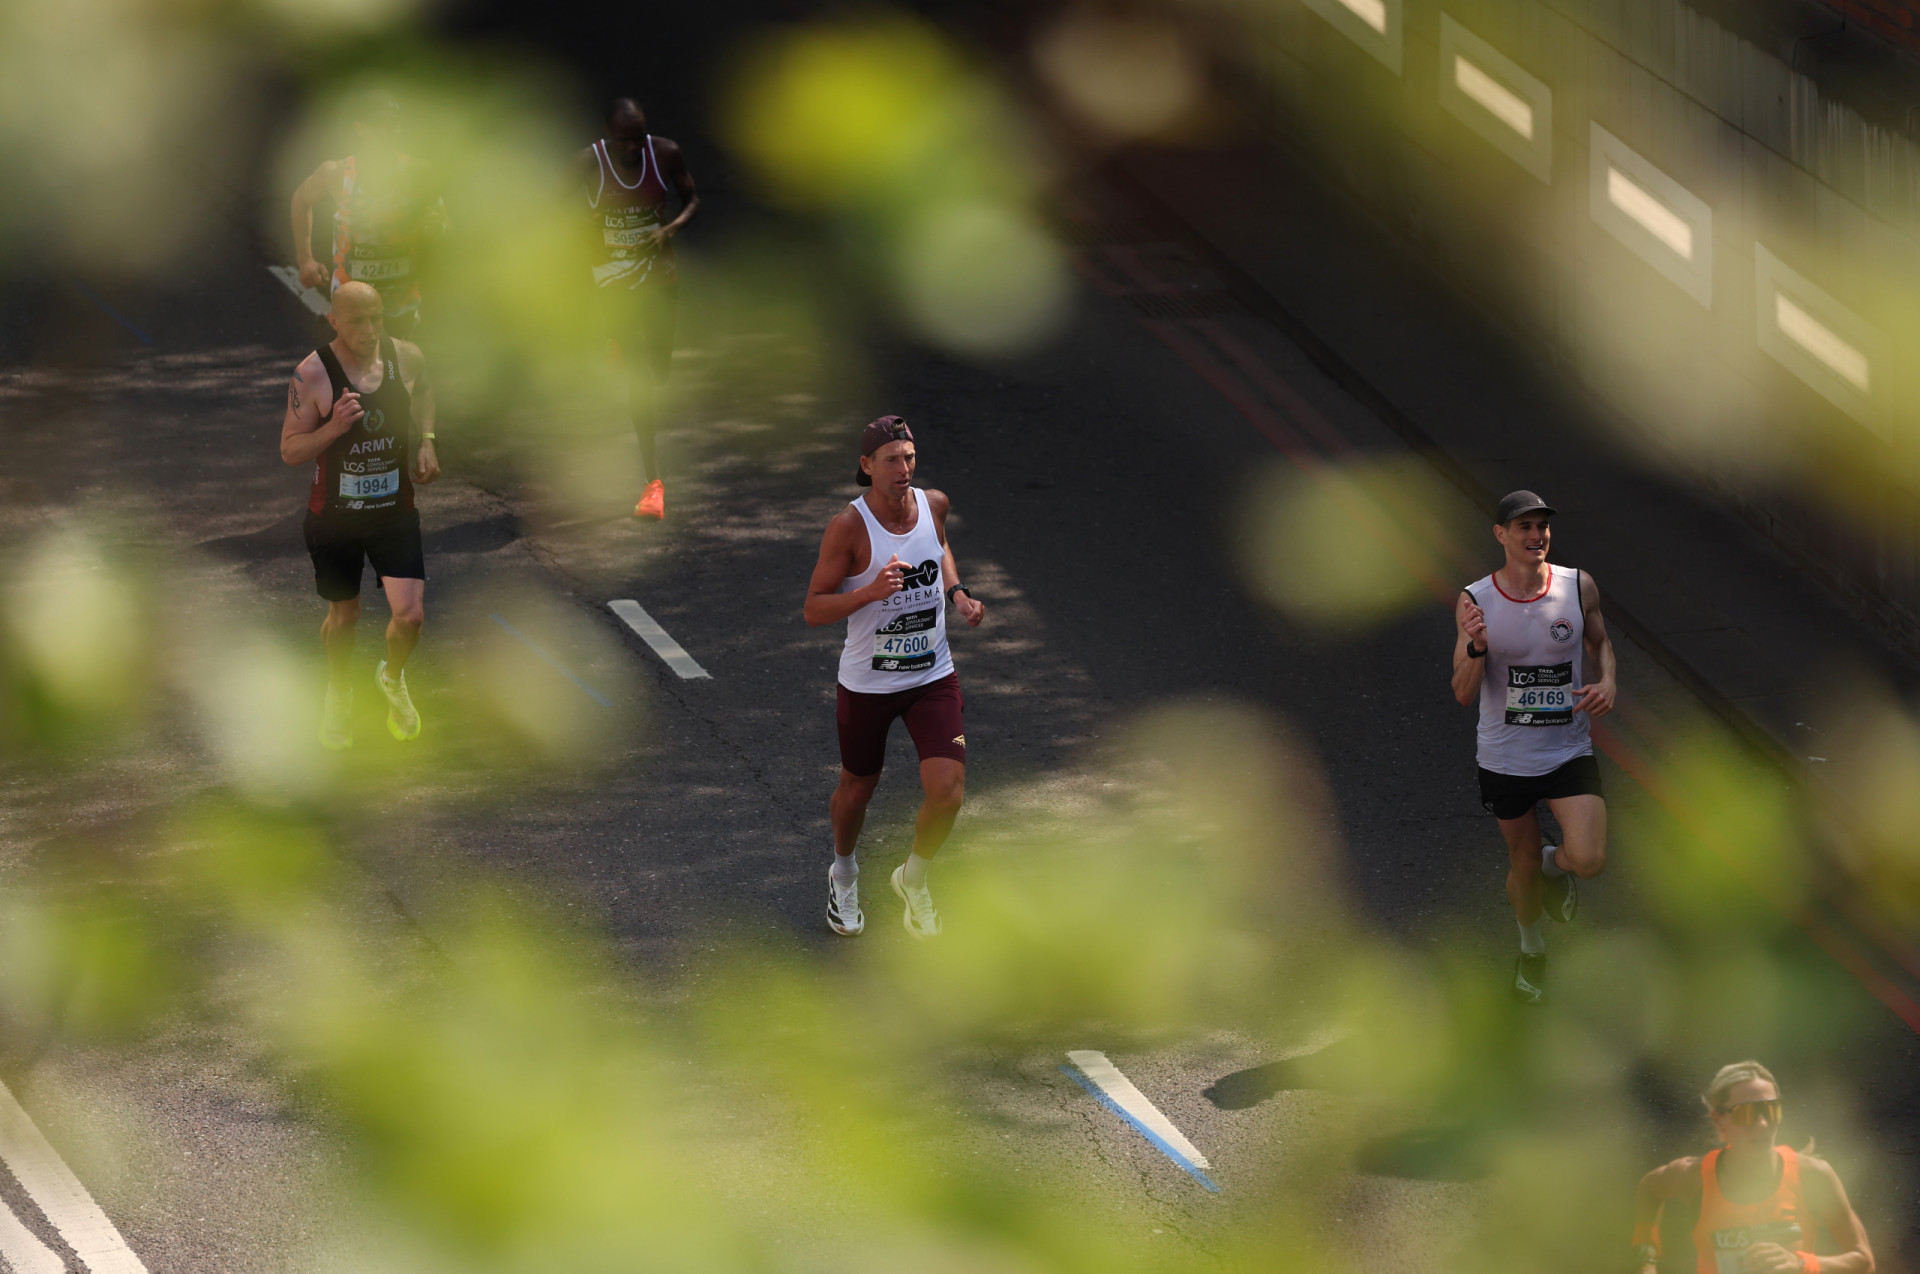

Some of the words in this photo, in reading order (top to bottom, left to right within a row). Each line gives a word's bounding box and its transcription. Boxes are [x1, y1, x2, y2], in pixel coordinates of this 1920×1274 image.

[349, 436, 395, 455] ARMY
[354, 477, 389, 494] 1994
[882, 587, 940, 606] SCHEMA
[884, 635, 928, 654] 47600
[911, 661, 931, 670] balance
[1510, 668, 1535, 685] tcs
[1518, 691, 1565, 706] 46169
